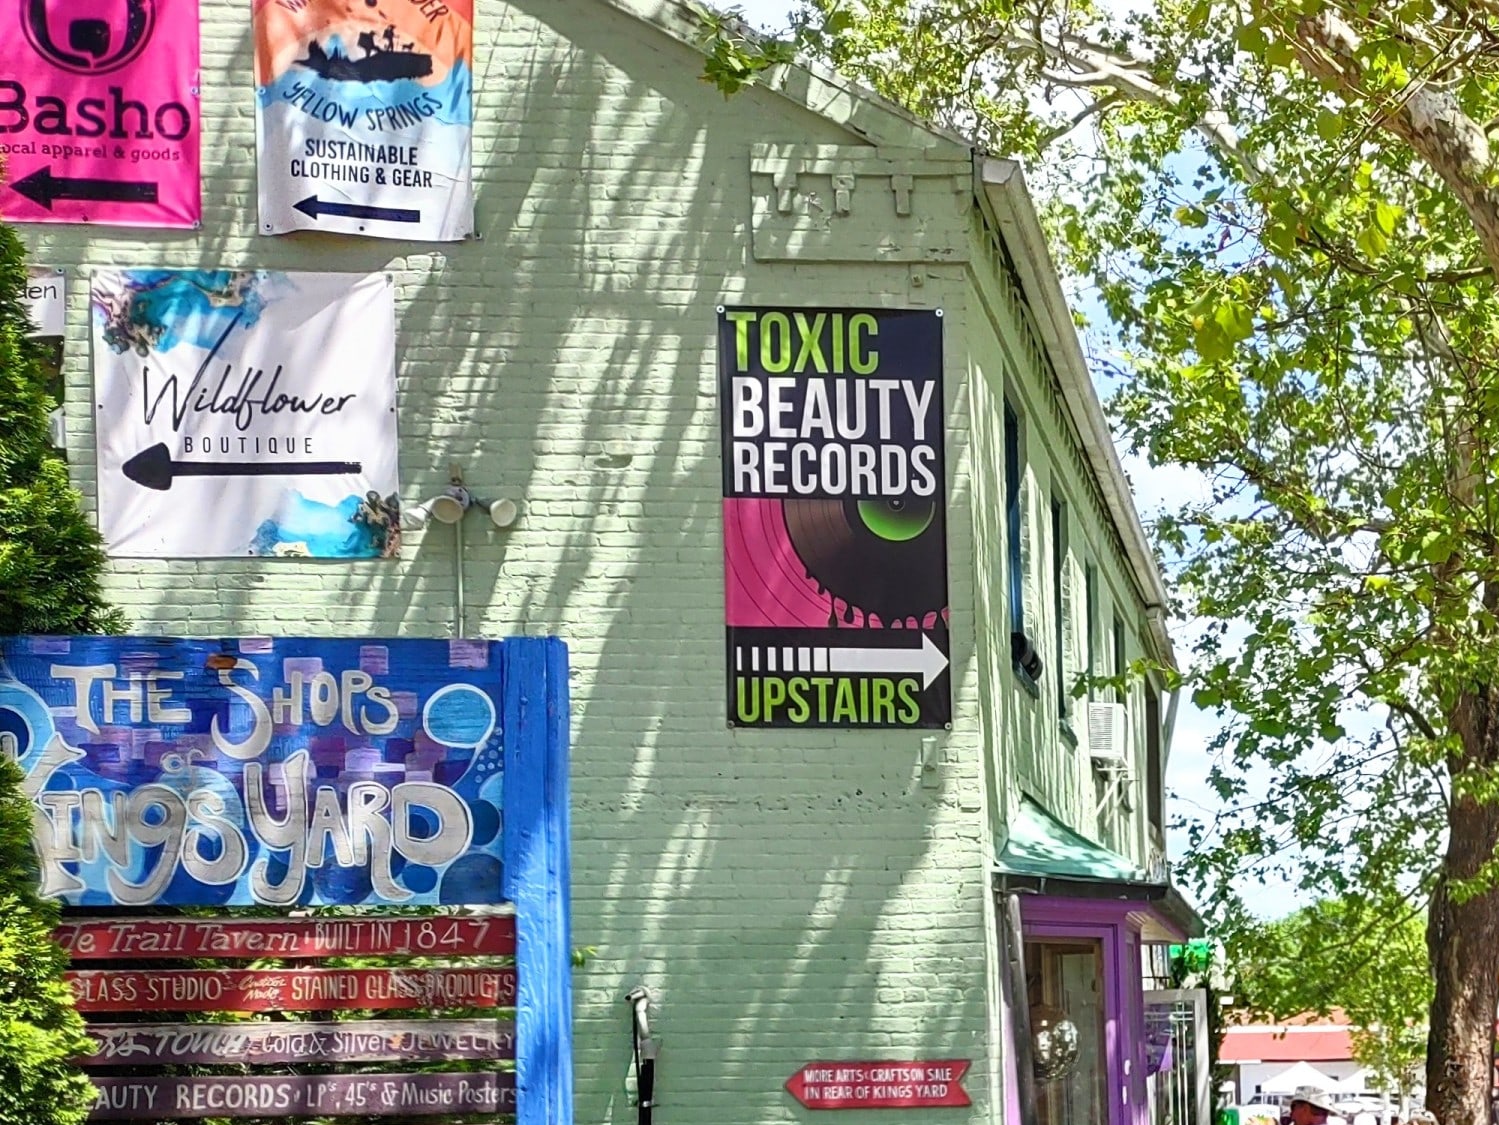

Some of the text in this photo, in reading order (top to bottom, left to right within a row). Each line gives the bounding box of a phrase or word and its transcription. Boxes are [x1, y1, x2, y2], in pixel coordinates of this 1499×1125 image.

[0, 80, 191, 141] Basho
[283, 82, 443, 132] YELLOW SPRINGS
[1, 142, 180, 163] ocal apparel & goods
[305, 138, 418, 166] SUSTAINABLE
[291, 159, 433, 188] CLOTHING & GEAR
[726, 311, 879, 375] TOXIC
[143, 311, 357, 432] Wildflower
[731, 376, 936, 440] BEAUTY
[184, 436, 314, 455] BOUTIQUE
[734, 441, 936, 497] RECORDS
[51, 663, 193, 735] THE
[736, 676, 921, 726] UPSTAIRS
[243, 748, 474, 906] YARD
[108, 923, 189, 952] Trail
[195, 923, 301, 952] Tavern
[314, 922, 367, 951] BUILT
[371, 922, 391, 949] IN
[402, 921, 490, 951] 1847
[149, 975, 222, 1001] STUDIO
[291, 975, 358, 1001] STAINED
[88, 1084, 157, 1110] AUTY
[177, 1083, 290, 1109] RECORDS
[381, 1081, 399, 1106] &
[401, 1082, 453, 1106] Music
[804, 1069, 833, 1083] MORE
[835, 1069, 864, 1082] ARTS
[870, 1068, 910, 1082] CRAFTS
[910, 1068, 924, 1082] ON
[928, 1068, 952, 1082] SALE
[804, 1084, 948, 1100] IN REAR OF KINGS YARD
